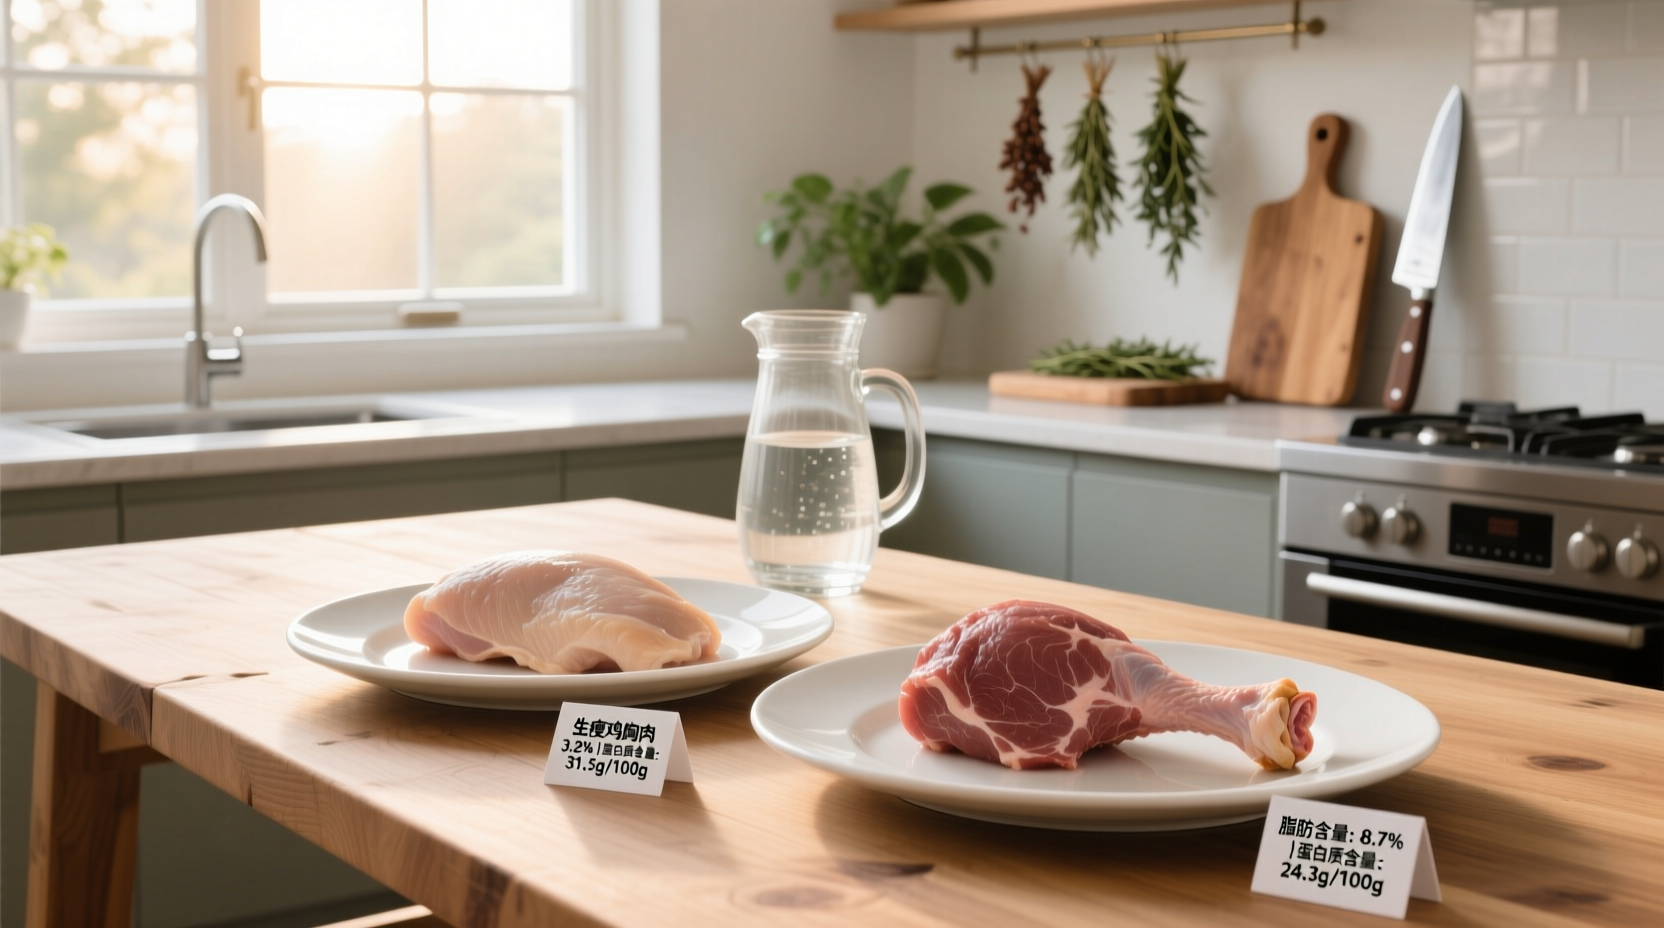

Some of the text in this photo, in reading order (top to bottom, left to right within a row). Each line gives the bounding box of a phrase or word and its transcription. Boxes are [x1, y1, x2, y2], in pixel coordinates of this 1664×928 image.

[561, 739, 593, 753] 3.2%
[565, 756, 648, 780] 31.5g/100g
[1359, 829, 1404, 850] 8.7%
[1280, 862, 1384, 897] 24.3g/100g
